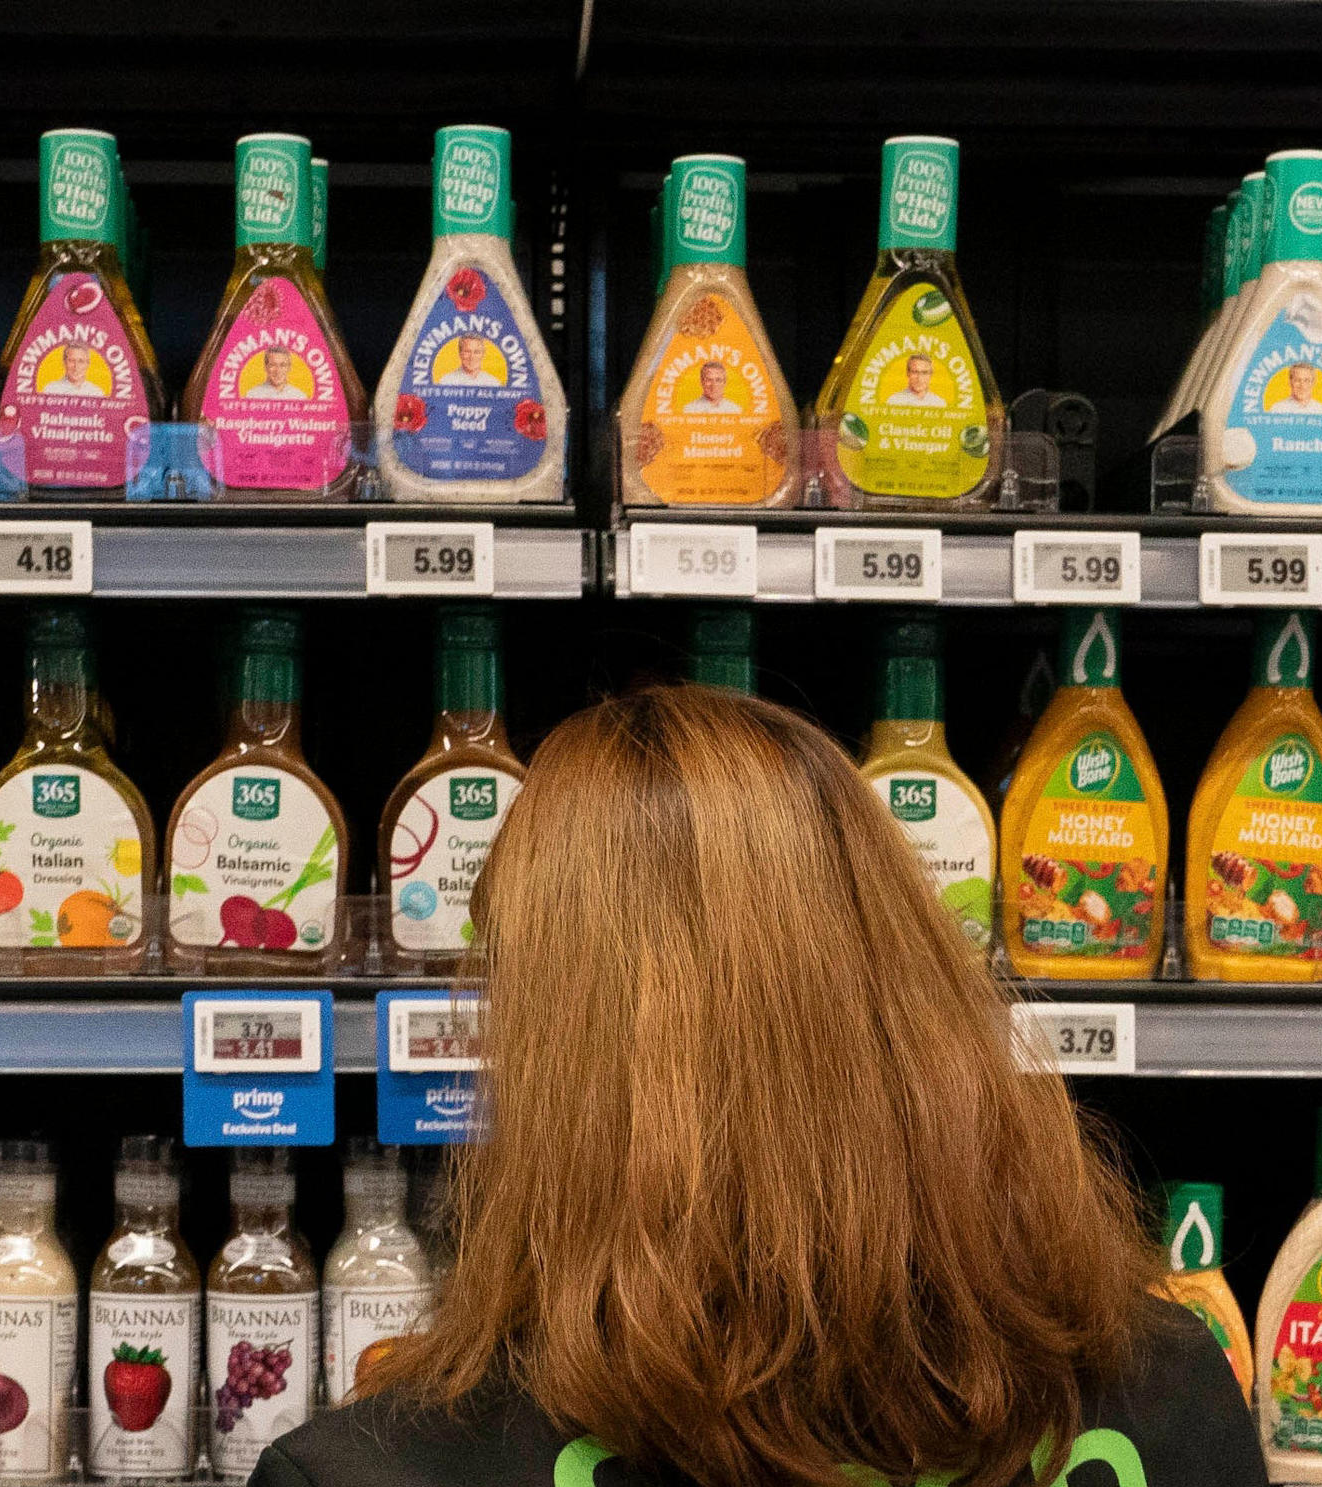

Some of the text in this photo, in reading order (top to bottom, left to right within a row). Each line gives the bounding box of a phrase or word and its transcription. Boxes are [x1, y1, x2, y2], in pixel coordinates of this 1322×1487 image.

[452, 147, 492, 167] 100%
[17, 325, 132, 399] NEWMAN'S OWN
[447, 405, 492, 422] Poppy
[215, 418, 336, 435] Raspberry Walnut
[879, 424, 925, 439] Classic
[691, 433, 734, 447] Honey
[683, 445, 743, 459] Mustard
[17, 547, 71, 570] 4.18
[677, 550, 737, 574] 5.99
[1060, 557, 1120, 582] 5.99
[1061, 812, 1127, 830] HONEY
[1251, 812, 1317, 831] HONEY
[1048, 829, 1134, 847] MUSTARD
[31, 854, 83, 869] Italian
[217, 856, 290, 872] Balsamic
[233, 1090, 283, 1108] prime
[95, 1306, 185, 1329] BRIANNAS
